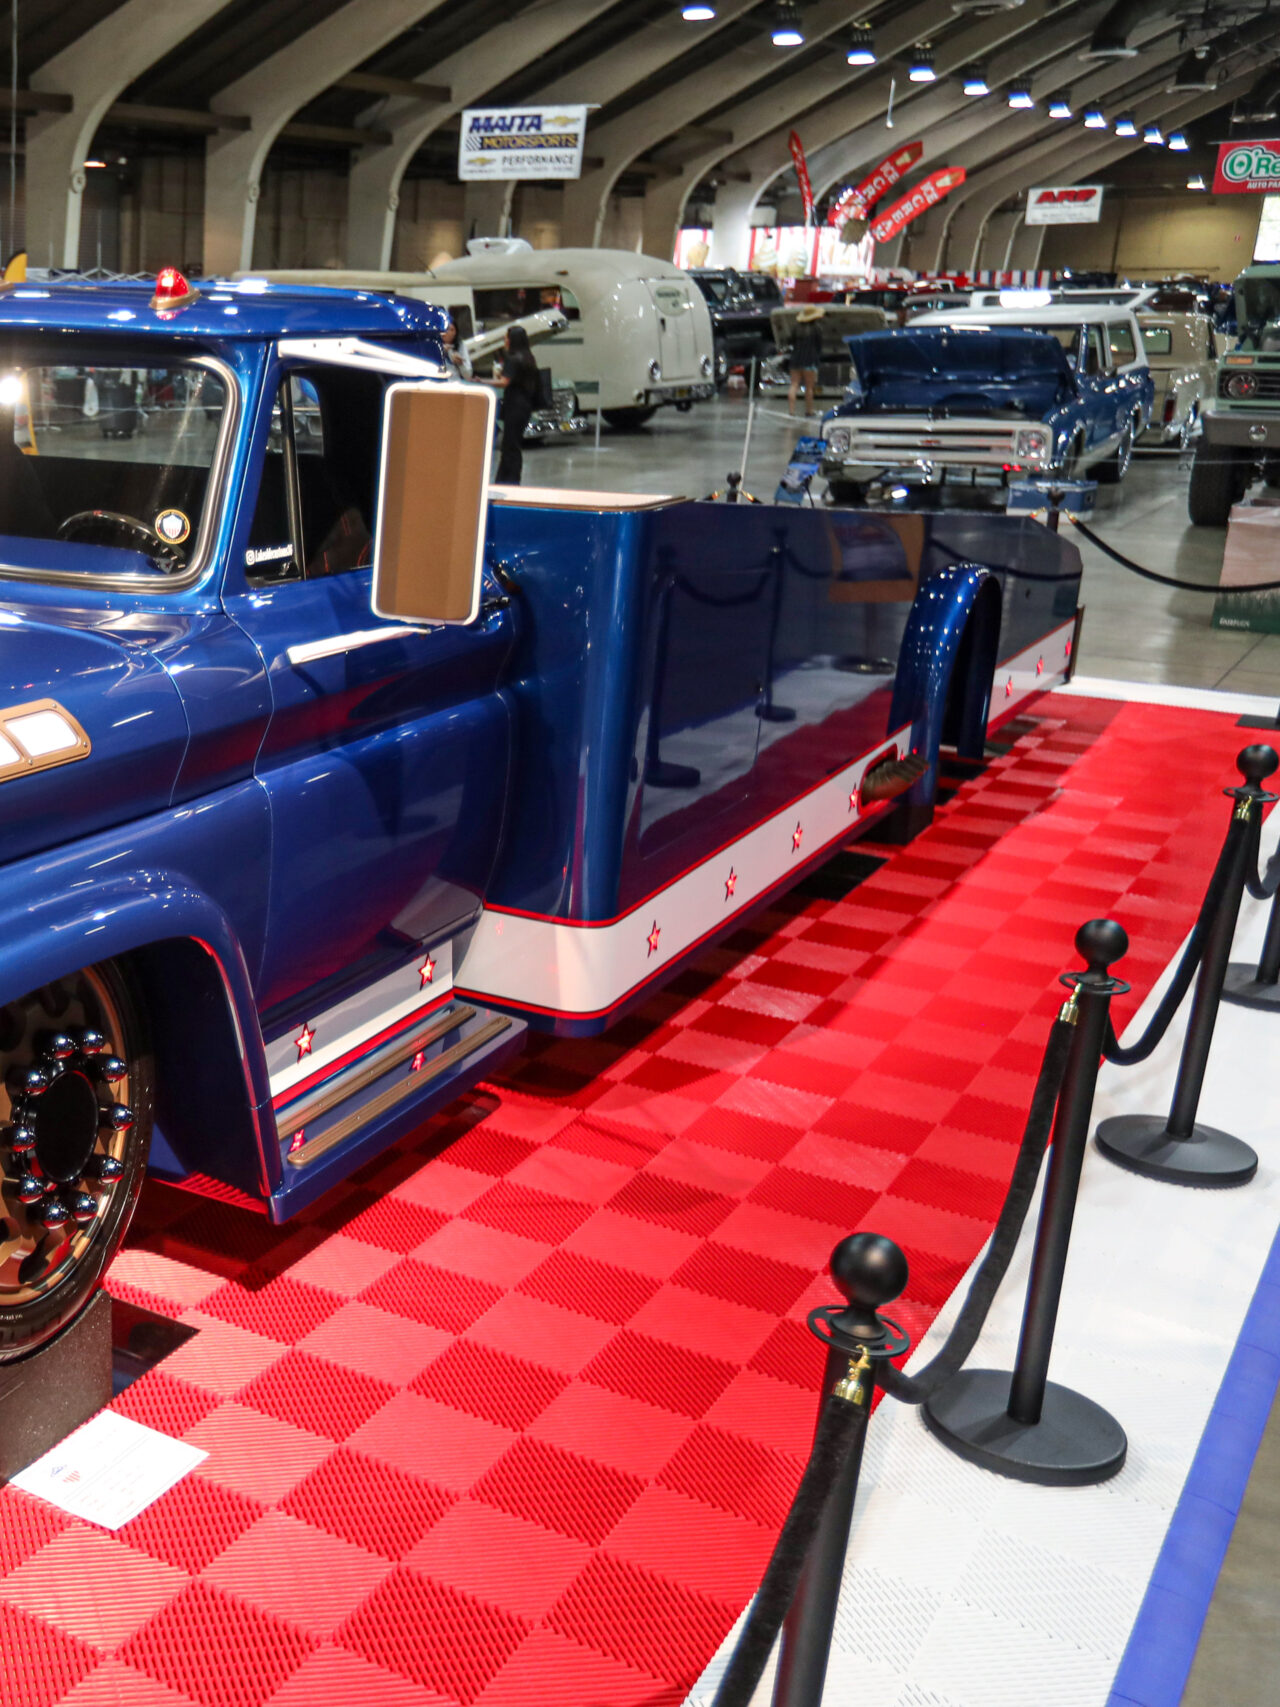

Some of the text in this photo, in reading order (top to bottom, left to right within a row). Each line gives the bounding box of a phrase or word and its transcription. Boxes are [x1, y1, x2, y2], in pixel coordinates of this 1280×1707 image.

[469, 114, 542, 134] MAITA
[481, 133, 578, 150] MOTORSPORTS
[501, 153, 575, 166] PERFORMANCE
[880, 161, 900, 184] ICE
[1034, 188, 1097, 205] ARP
[872, 181, 939, 240] ICE CREAM
